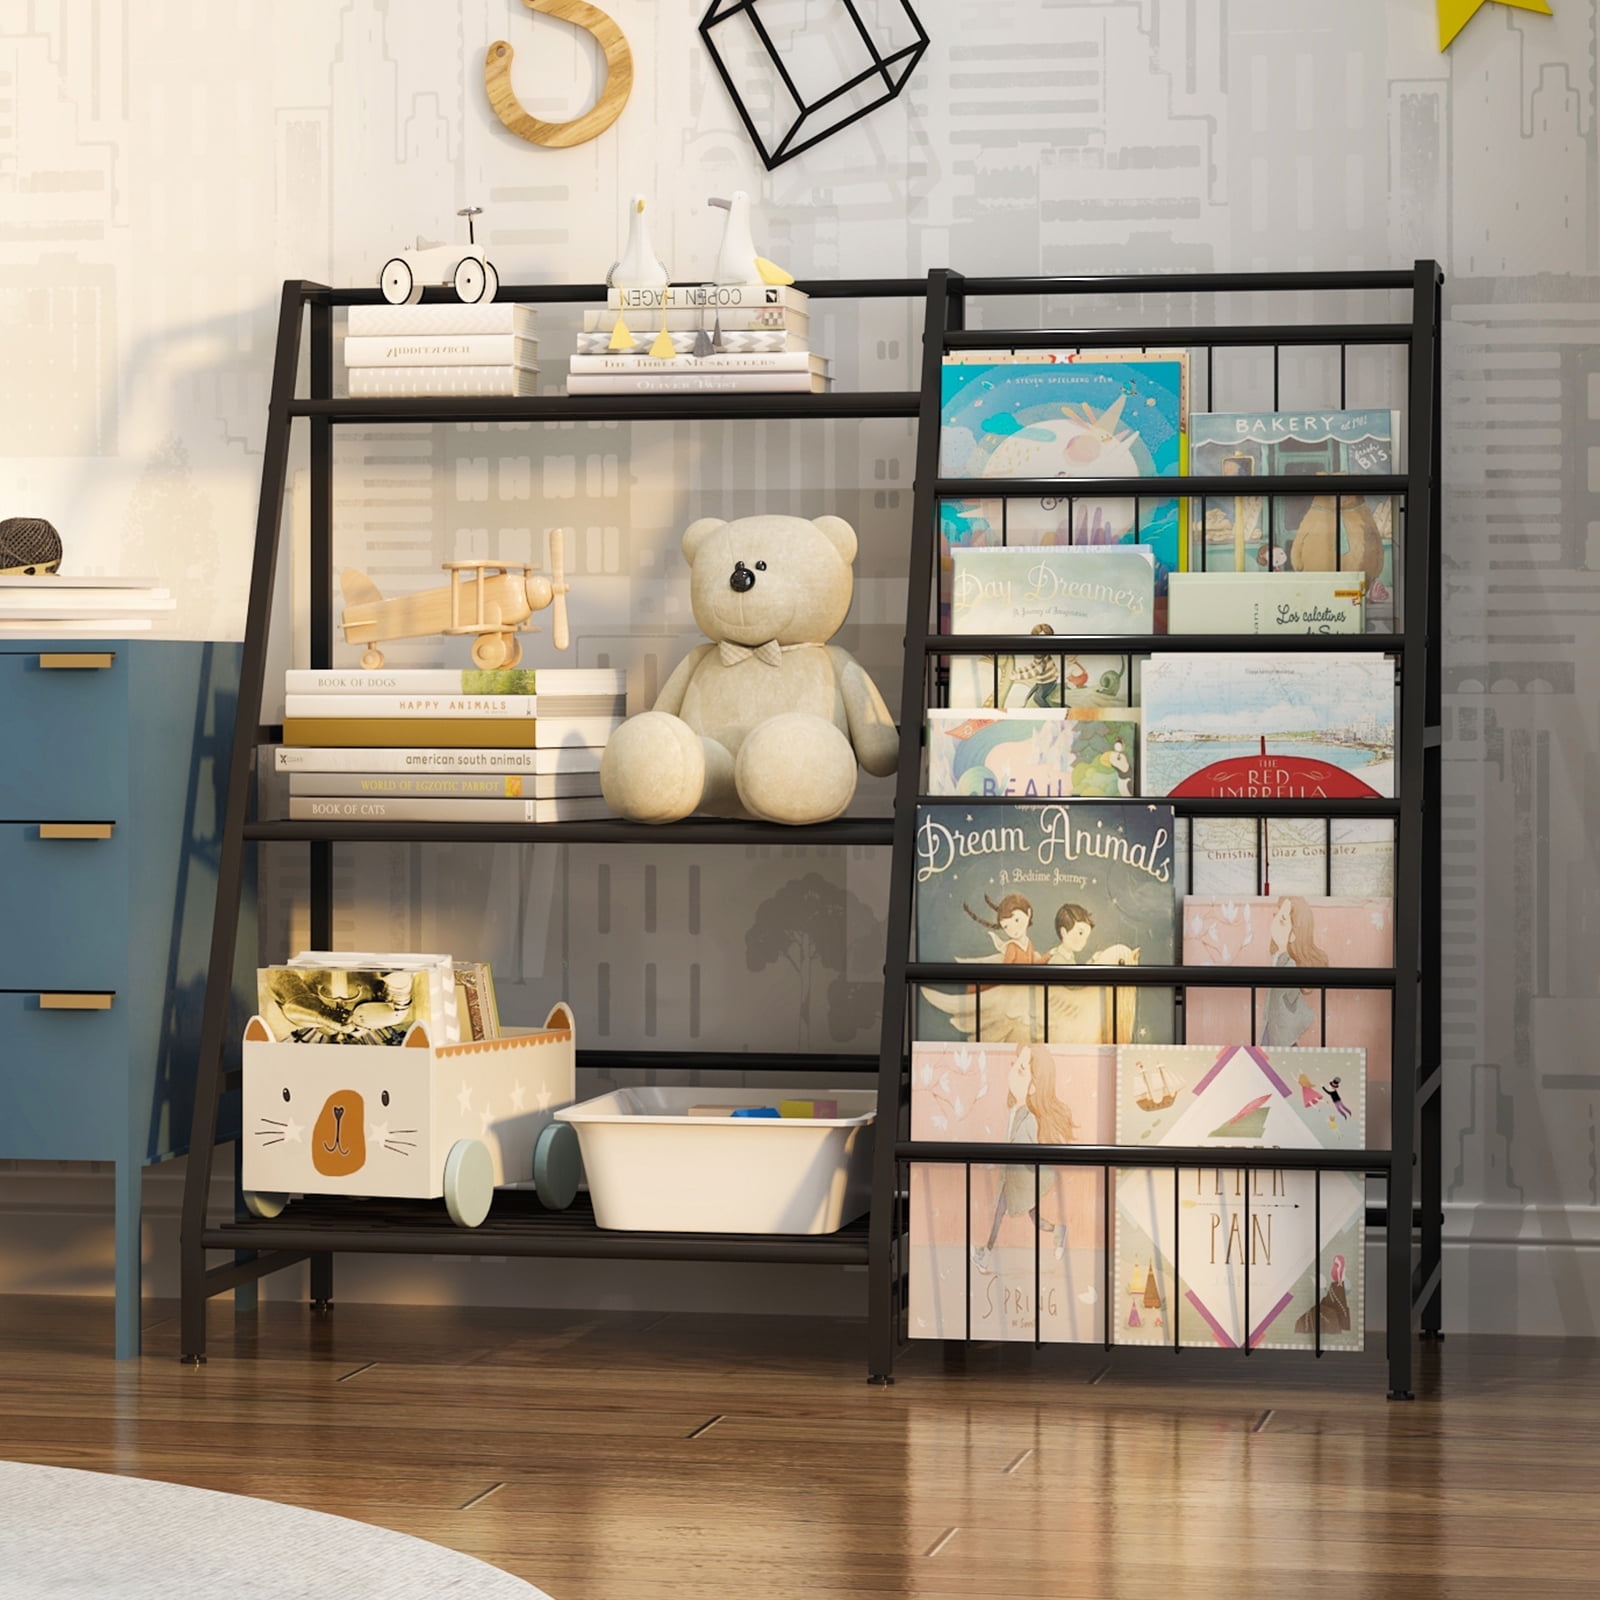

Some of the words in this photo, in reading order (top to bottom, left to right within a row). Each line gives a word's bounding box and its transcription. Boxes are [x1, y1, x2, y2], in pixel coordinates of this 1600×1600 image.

[620, 289, 675, 307] HAGEN
[685, 288, 742, 306] COPEN
[1235, 416, 1334, 433] BAKERY
[954, 568, 1012, 613] Day
[1024, 559, 1145, 615] Dreamers
[1276, 603, 1300, 625] Los
[1302, 605, 1347, 623] calcetines
[317, 678, 347, 688] BOOK
[350, 678, 364, 688] OF
[367, 678, 397, 688] DOGS
[399, 700, 440, 711] HAPPY
[449, 700, 508, 711] ANIMALS
[405, 753, 455, 766] american
[457, 753, 487, 766] south
[490, 753, 532, 767] animals
[1259, 759, 1279, 768] THE
[360, 779, 397, 791] WORLD
[398, 780, 412, 791] OF
[415, 780, 458, 792] EGZOTIC
[462, 780, 500, 792] PARROT
[1248, 769, 1291, 785] RED
[311, 803, 341, 815] BOOK
[344, 804, 358, 815] OF
[360, 804, 386, 815] CATS
[917, 813, 1031, 883] Dream
[1037, 805, 1172, 883] Animals
[1012, 867, 1051, 883] Bedtime
[1053, 867, 1088, 890] Journey
[1209, 1212, 1273, 1266] PAN
